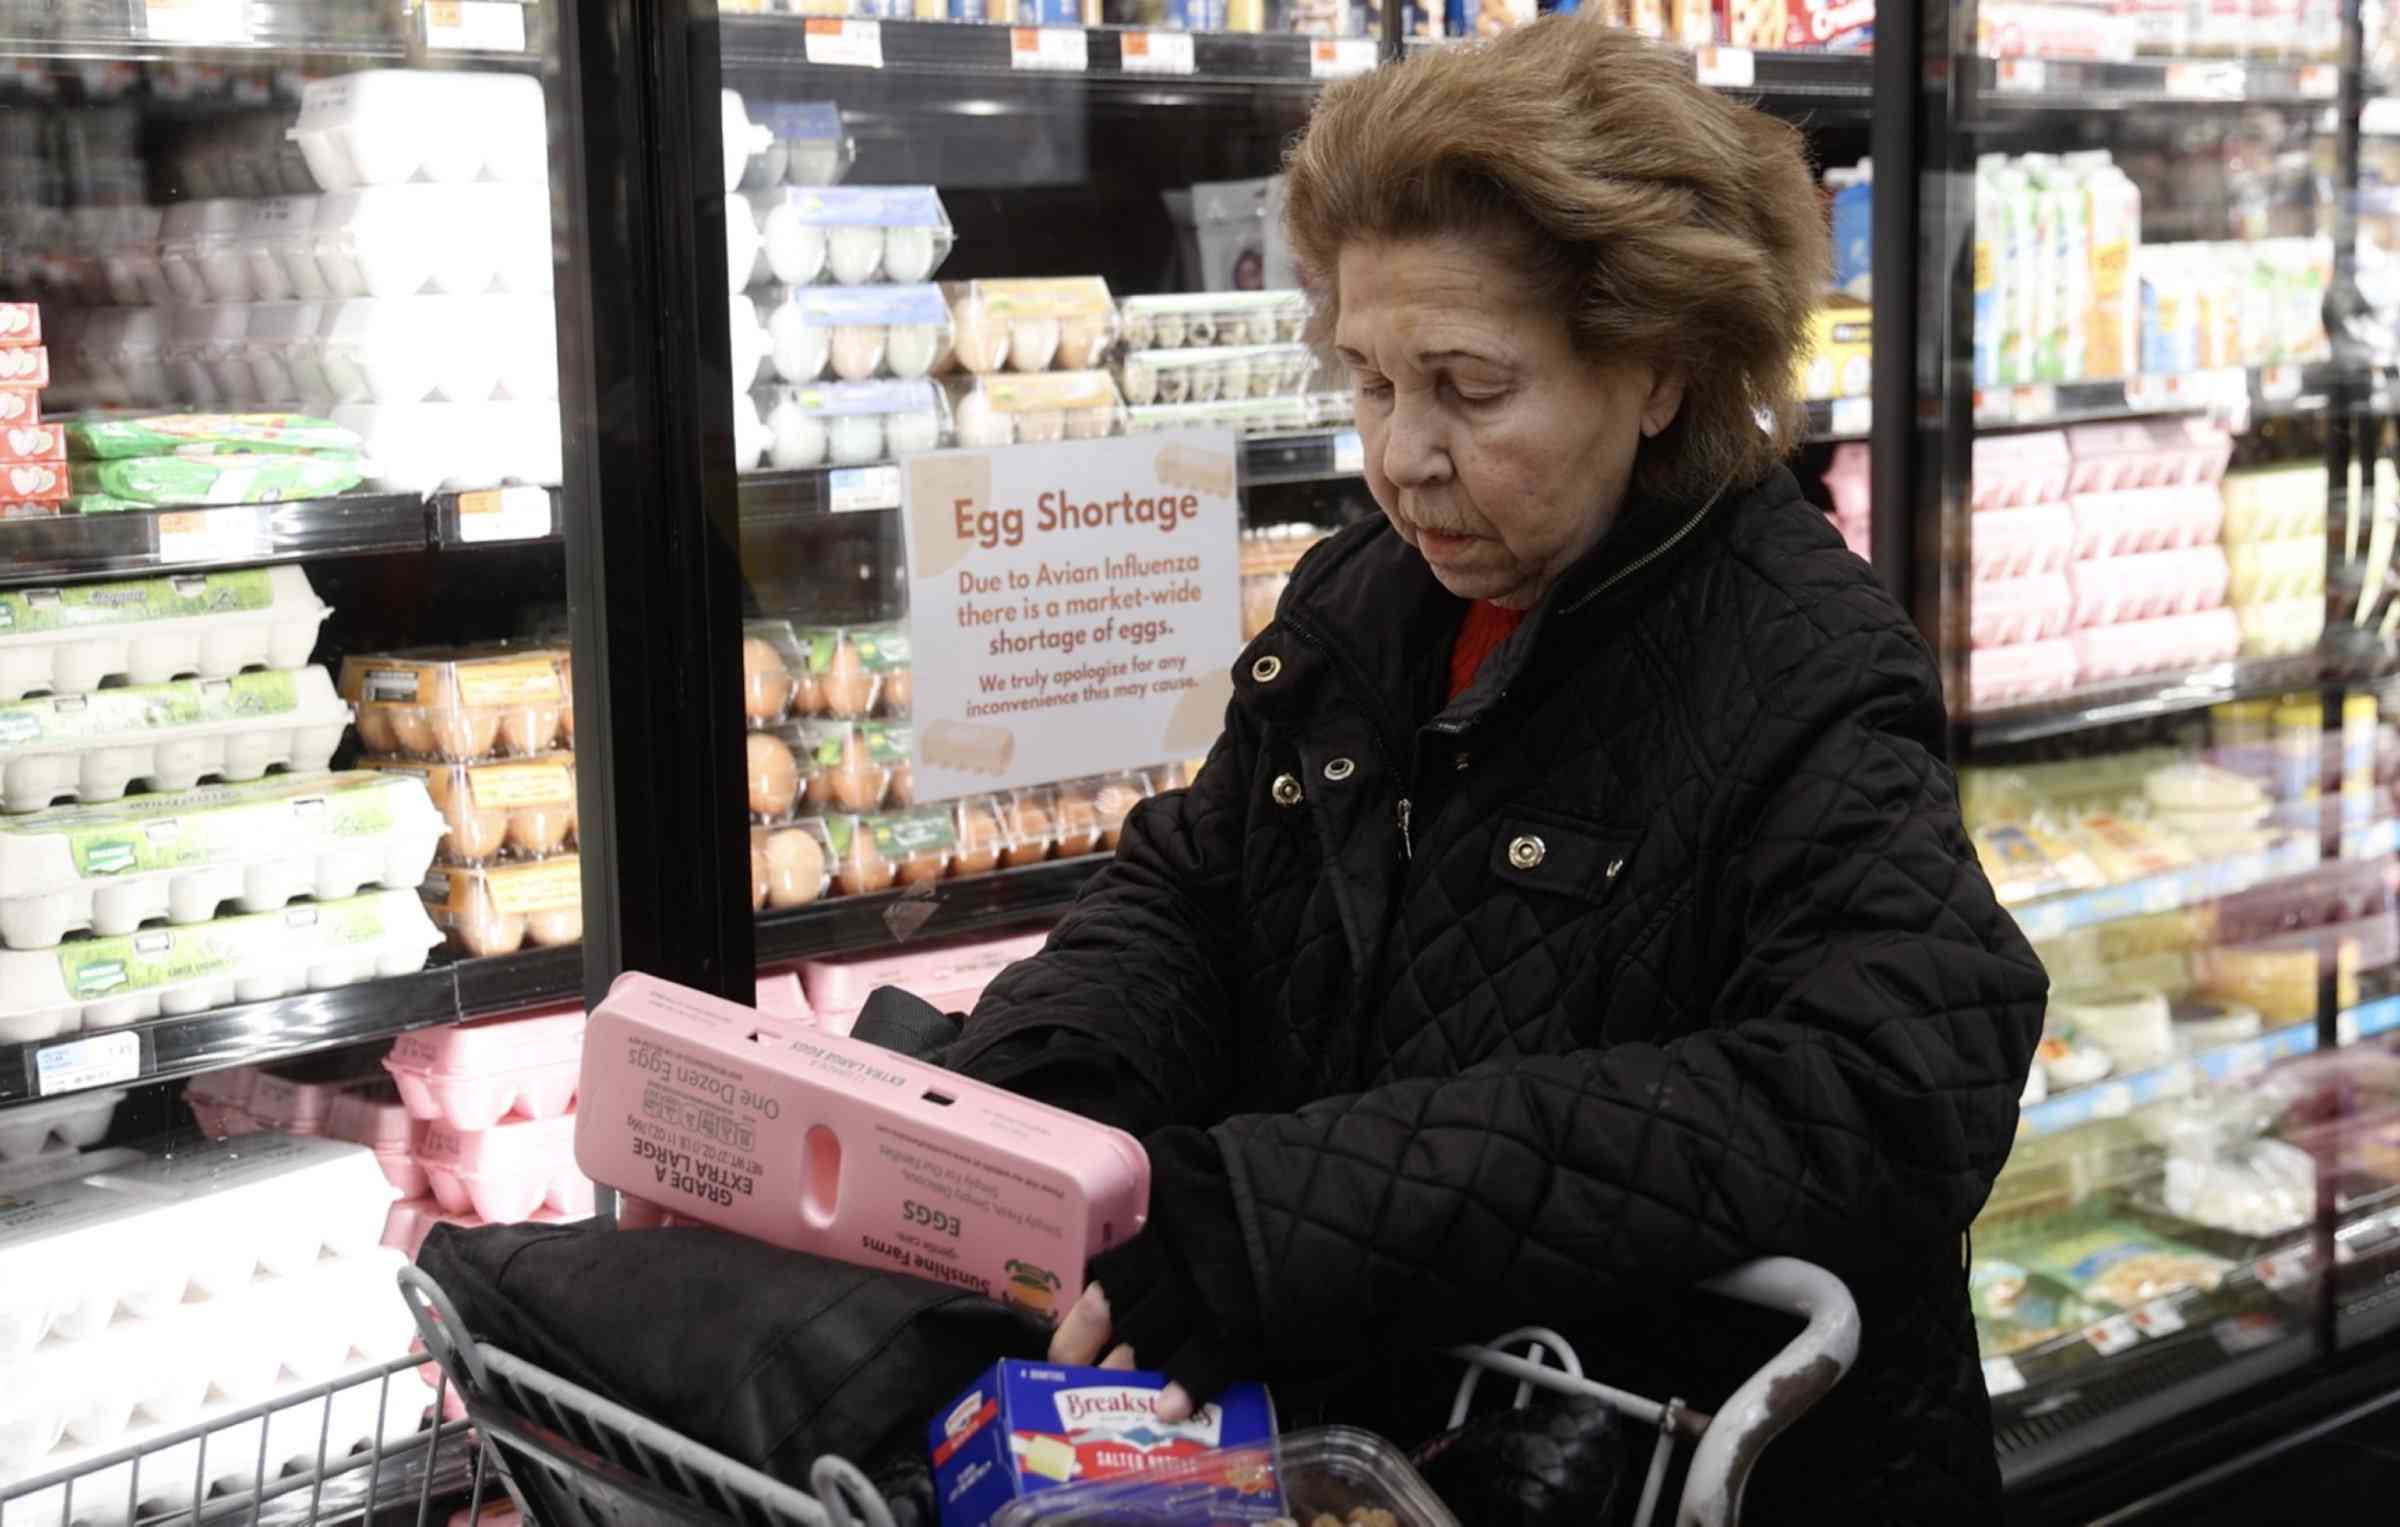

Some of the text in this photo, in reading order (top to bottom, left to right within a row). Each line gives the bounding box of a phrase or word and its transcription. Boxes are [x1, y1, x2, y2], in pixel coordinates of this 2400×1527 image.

[953, 490, 1199, 549] Egg Shortage
[959, 553, 1200, 595] Due to Avian Influenza
[958, 577, 1202, 627] there is a market-wide
[989, 617, 1174, 656] shortage of eggs.
[979, 655, 1186, 694] We truly apologize for any
[966, 676, 1200, 717] inconvenience this may cause.
[628, 1047, 671, 1082] Eggs
[677, 1065, 736, 1104] Dozen
[740, 1088, 779, 1121] One
[632, 1136, 753, 1196] EXTRA LARGE
[654, 1163, 732, 1208] GRADE A
[901, 1197, 961, 1238] EGGS
[862, 1234, 990, 1296] Sunshine Farms
[1065, 1391, 1213, 1426] Breaksts
